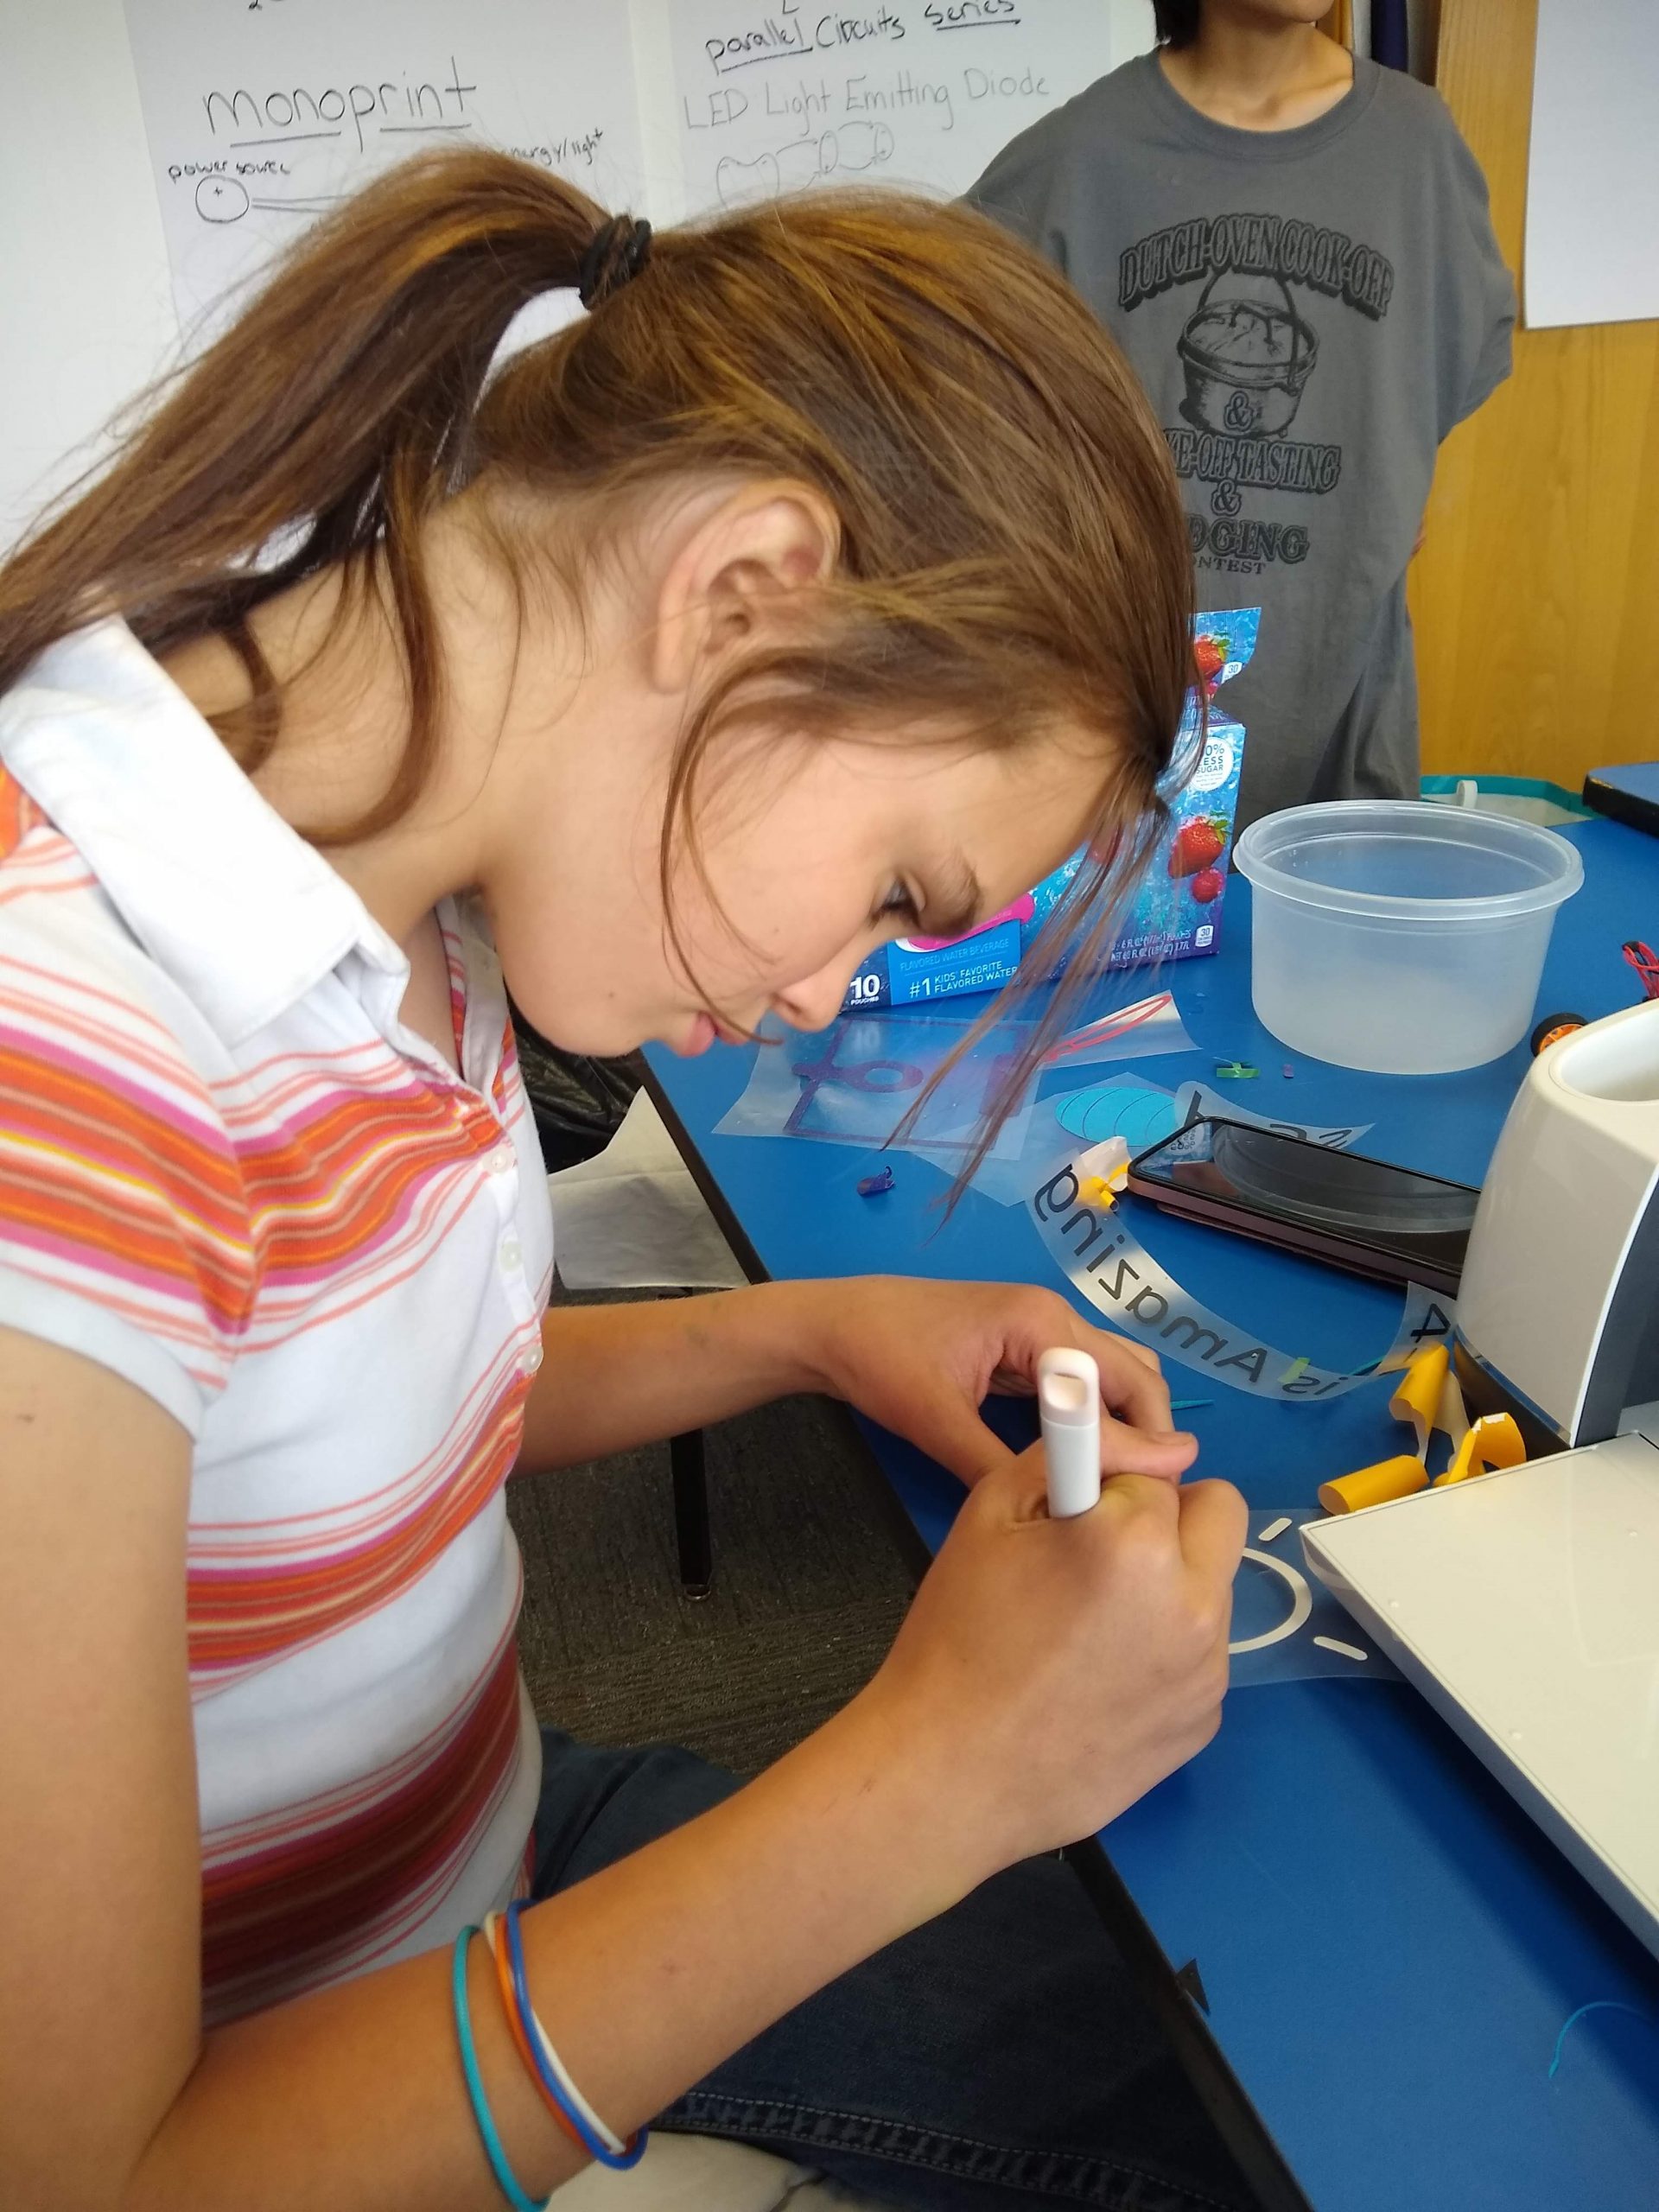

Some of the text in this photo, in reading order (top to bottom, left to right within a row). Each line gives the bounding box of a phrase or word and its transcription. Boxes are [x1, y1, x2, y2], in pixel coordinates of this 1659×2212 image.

[815, 9, 906, 48] Circuits
[684, 67, 1052, 137] LED Light Emitting Diode
[1224, 390, 1253, 431] &
[1236, 438, 1342, 494] TASTING
[1211, 477, 1243, 517] &
[1189, 513, 1311, 564] DGING
[1197, 555, 1267, 575] NTEST
[1228, 664, 1239, 674] 30
[1203, 755, 1224, 767] ESS
[1205, 743, 1225, 757] 0%
[1196, 764, 1224, 775] SUGAR
[899, 938, 1010, 971] FLAVORED WATER BEVERAGE
[934, 965, 1018, 994] FLAVORED WATER
[960, 960, 1003, 977] FAVORITE
[849, 974, 880, 999] 10
[909, 977, 931, 998] #1
